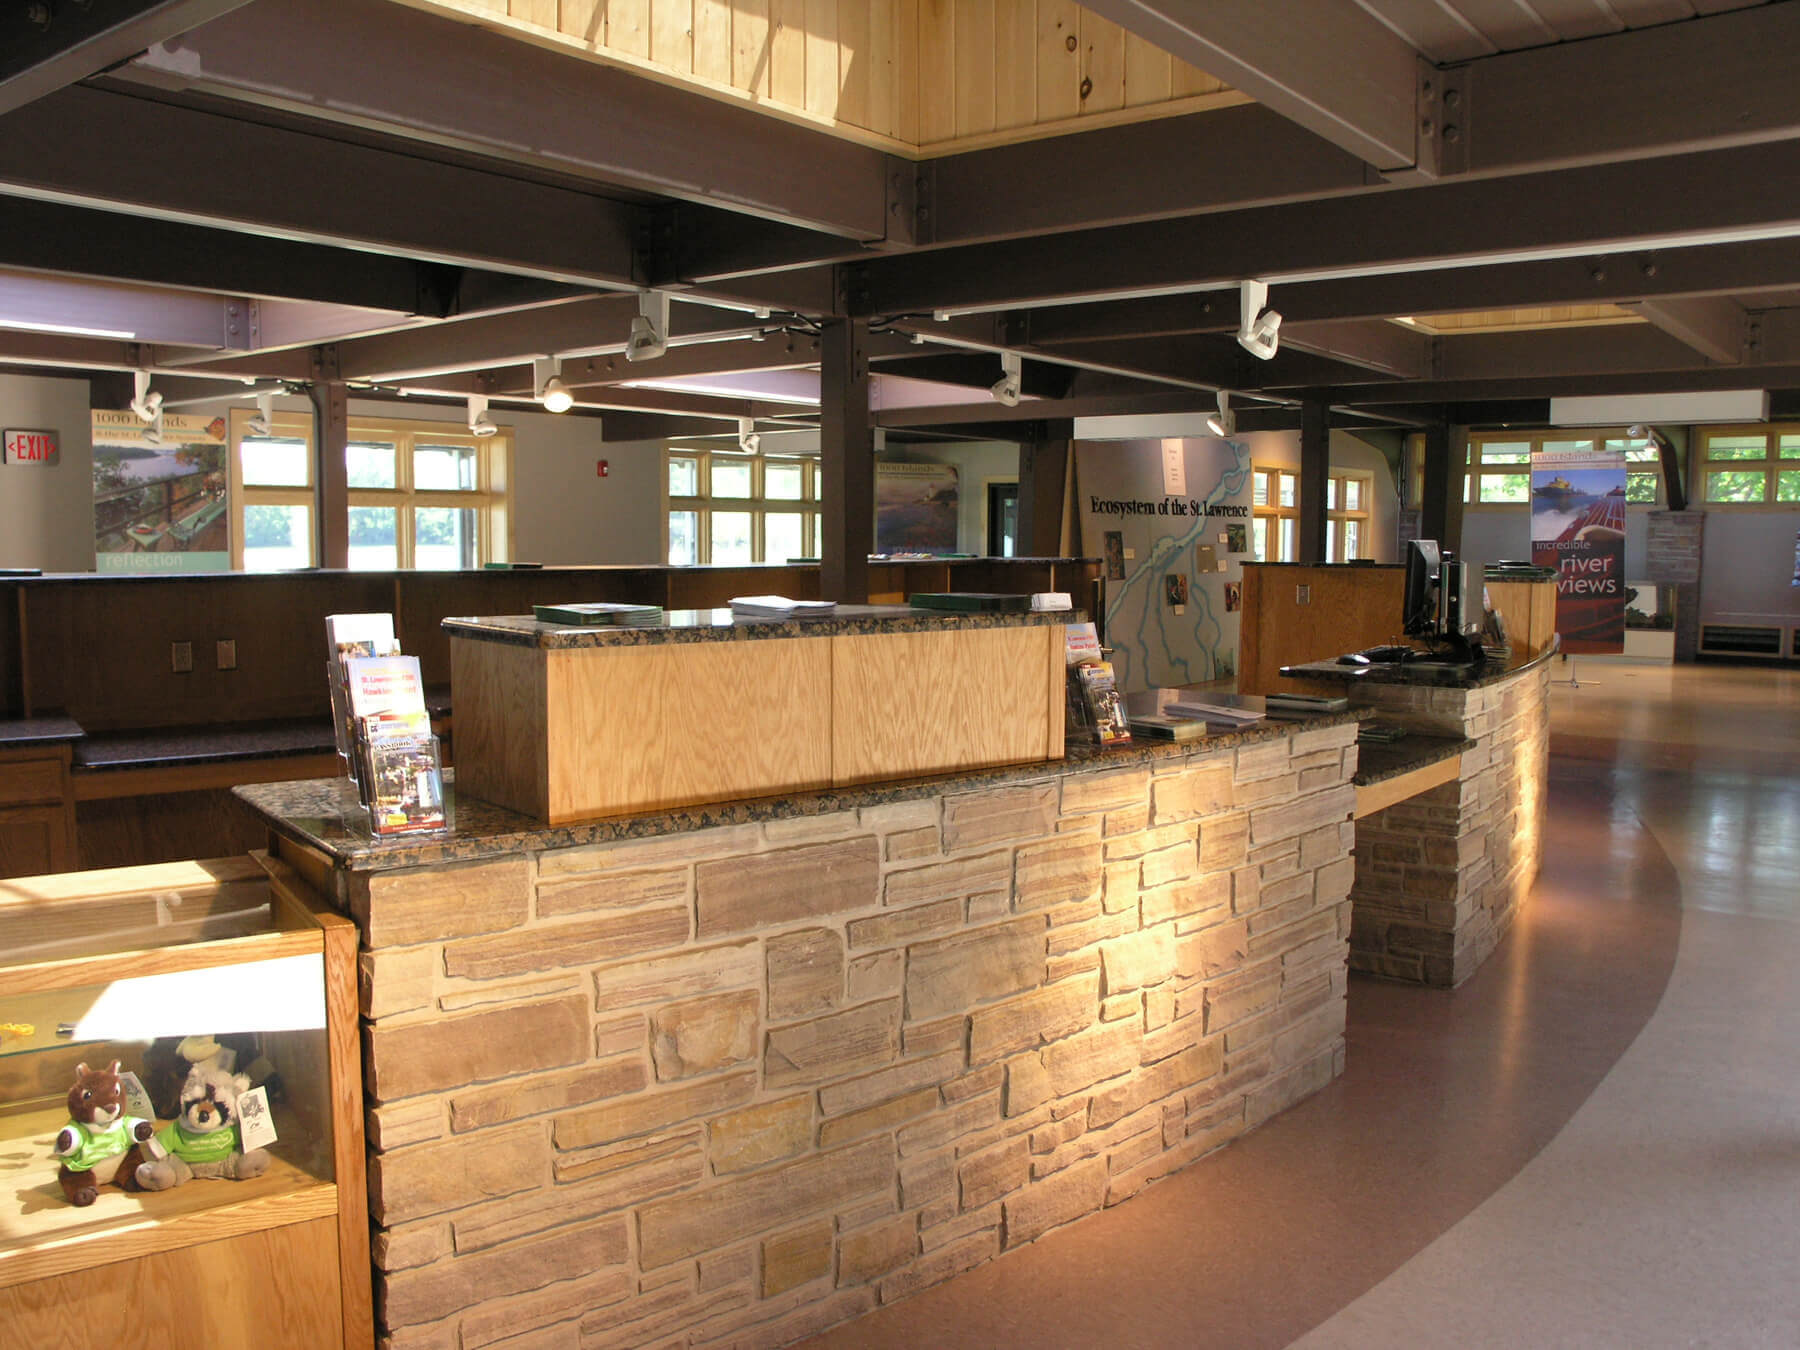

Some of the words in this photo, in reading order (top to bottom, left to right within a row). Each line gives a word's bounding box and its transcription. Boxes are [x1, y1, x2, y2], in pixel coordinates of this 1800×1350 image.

[96, 412, 130, 425] 1000
[17, 434, 49, 461] EXIT
[1091, 496, 1155, 520] Ecosystem
[1158, 498, 1170, 515] of
[1172, 500, 1187, 516] the
[1190, 499, 1202, 516] St.
[1203, 500, 1248, 517] Lawrence
[1536, 540, 1591, 550] incredible
[106, 552, 183, 568] reflection
[1561, 554, 1613, 573] river
[1558, 575, 1617, 594] views
